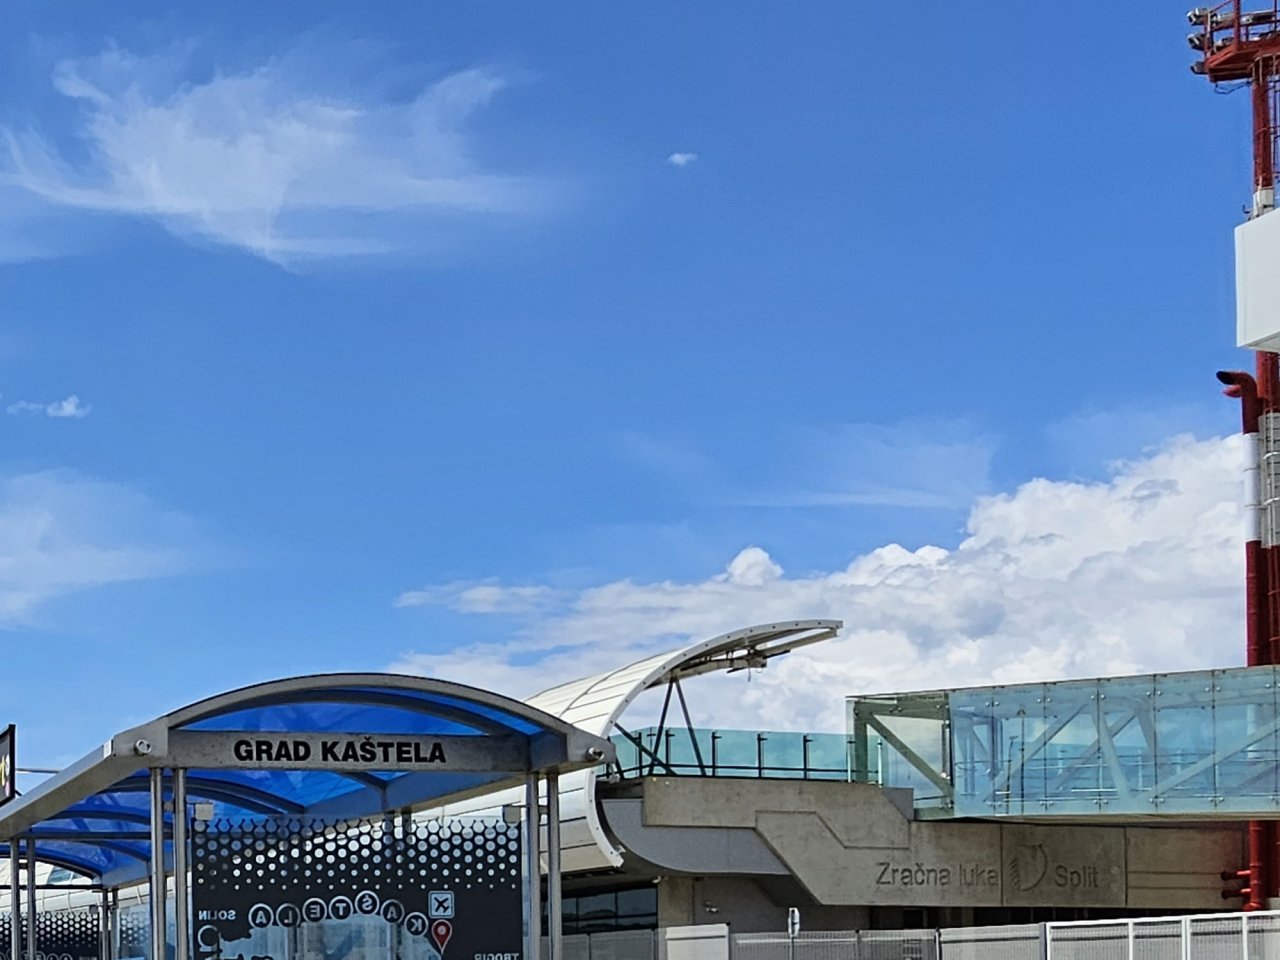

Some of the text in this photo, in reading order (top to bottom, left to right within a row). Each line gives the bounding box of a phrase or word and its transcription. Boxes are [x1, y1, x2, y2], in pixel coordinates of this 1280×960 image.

[233, 736, 447, 764] GRAD KAŠTELA
[876, 862, 1098, 888] Zračna luka Split
